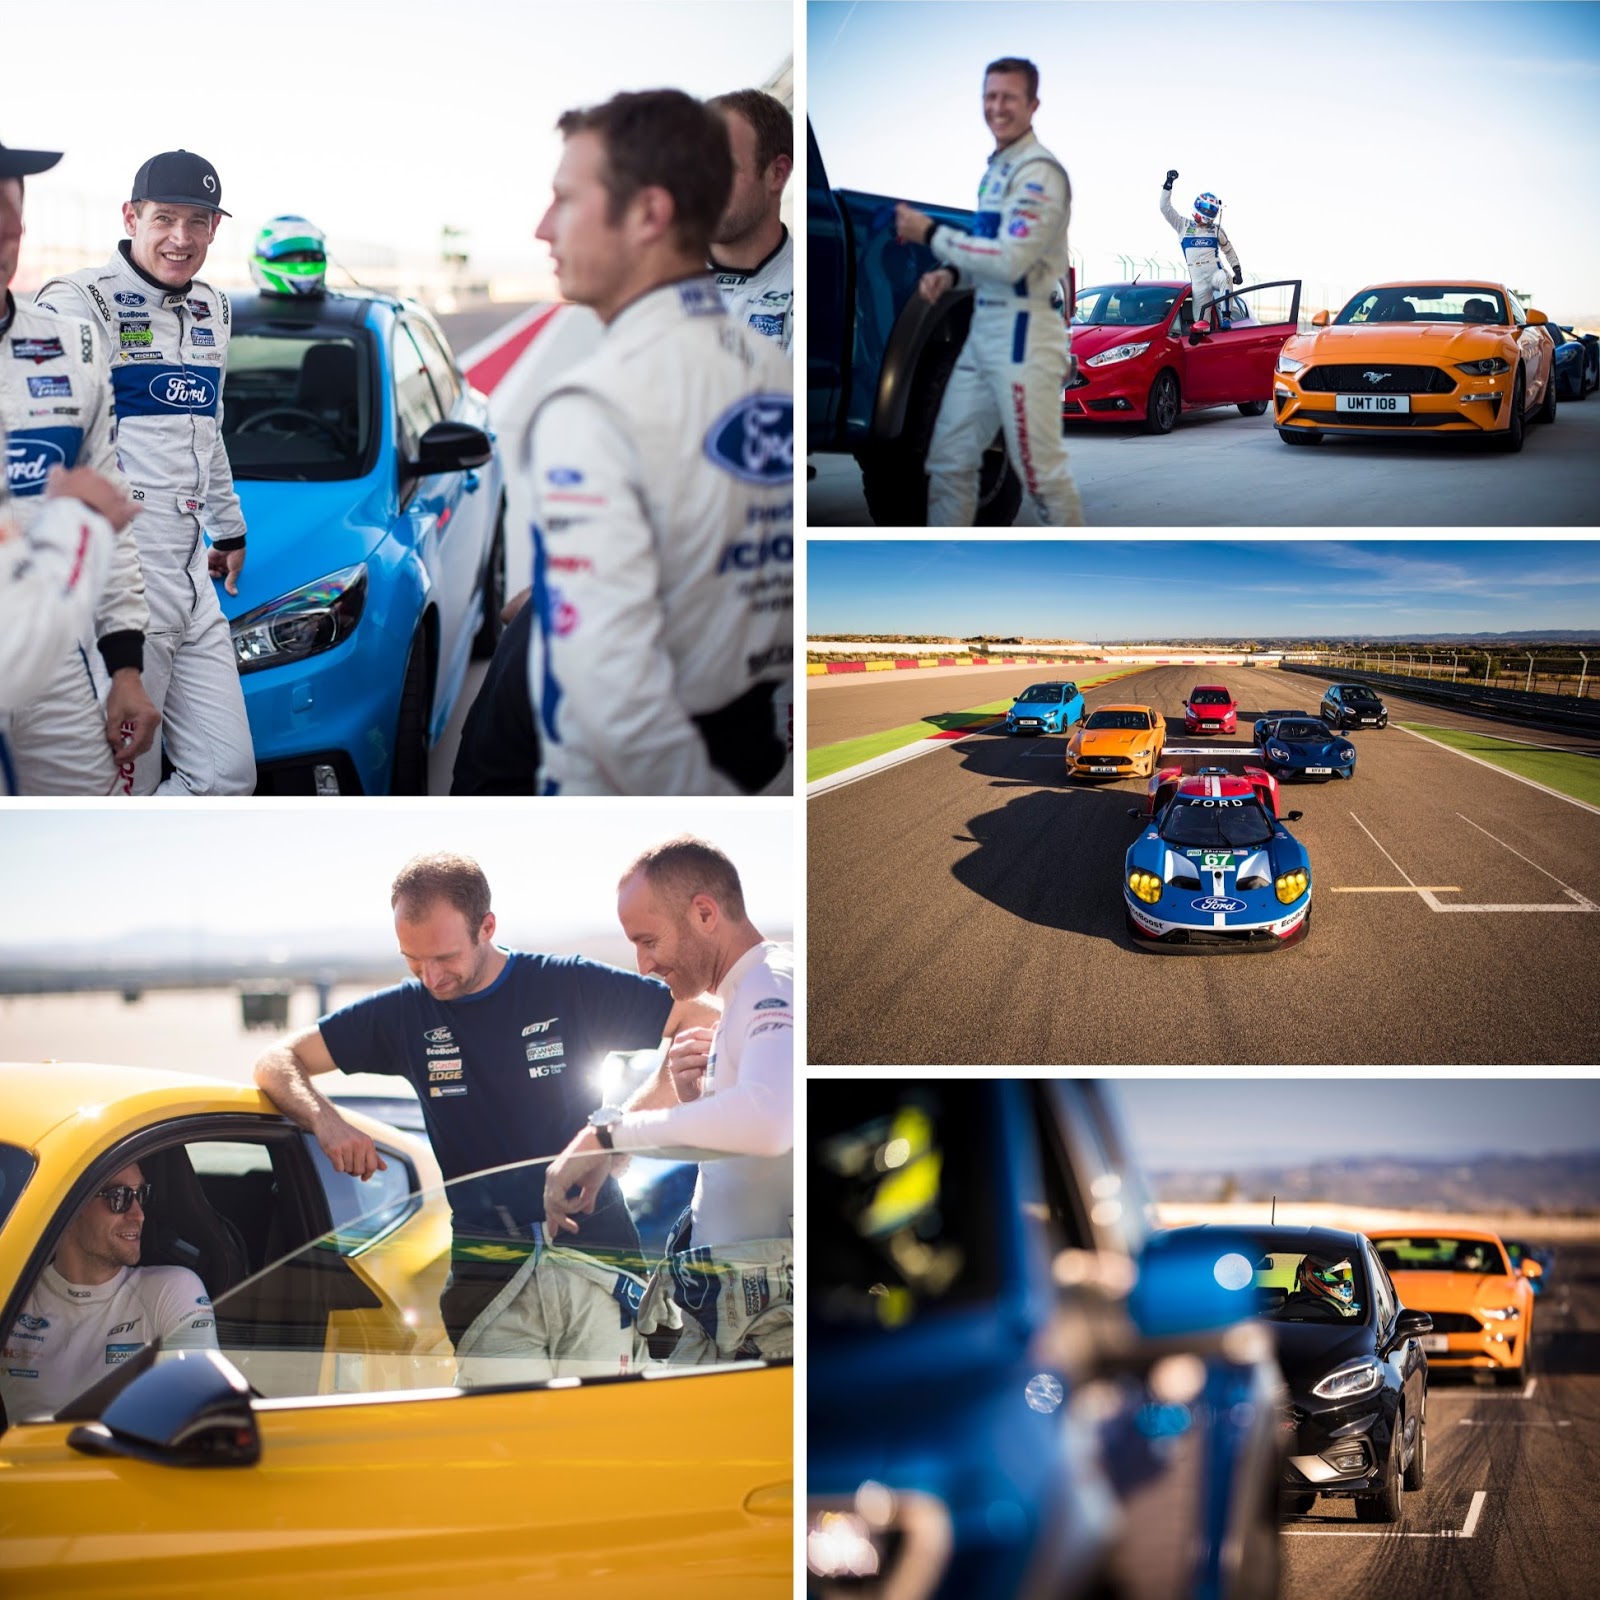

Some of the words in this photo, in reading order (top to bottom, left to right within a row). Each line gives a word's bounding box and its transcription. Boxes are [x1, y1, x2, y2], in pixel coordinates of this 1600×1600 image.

[87, 284, 111, 322] sparco
[120, 292, 140, 304] Ford
[166, 377, 207, 404] Ford
[1347, 396, 1372, 410] UMT
[1376, 397, 1397, 410] 108
[1190, 799, 1243, 808] FORD
[1204, 853, 1231, 867] 67
[1201, 897, 1237, 911] Ford
[431, 1028, 452, 1041] Ford
[426, 1046, 460, 1056] EcoBoost
[435, 1061, 460, 1070] Castrol
[429, 1070, 464, 1081] EDGE
